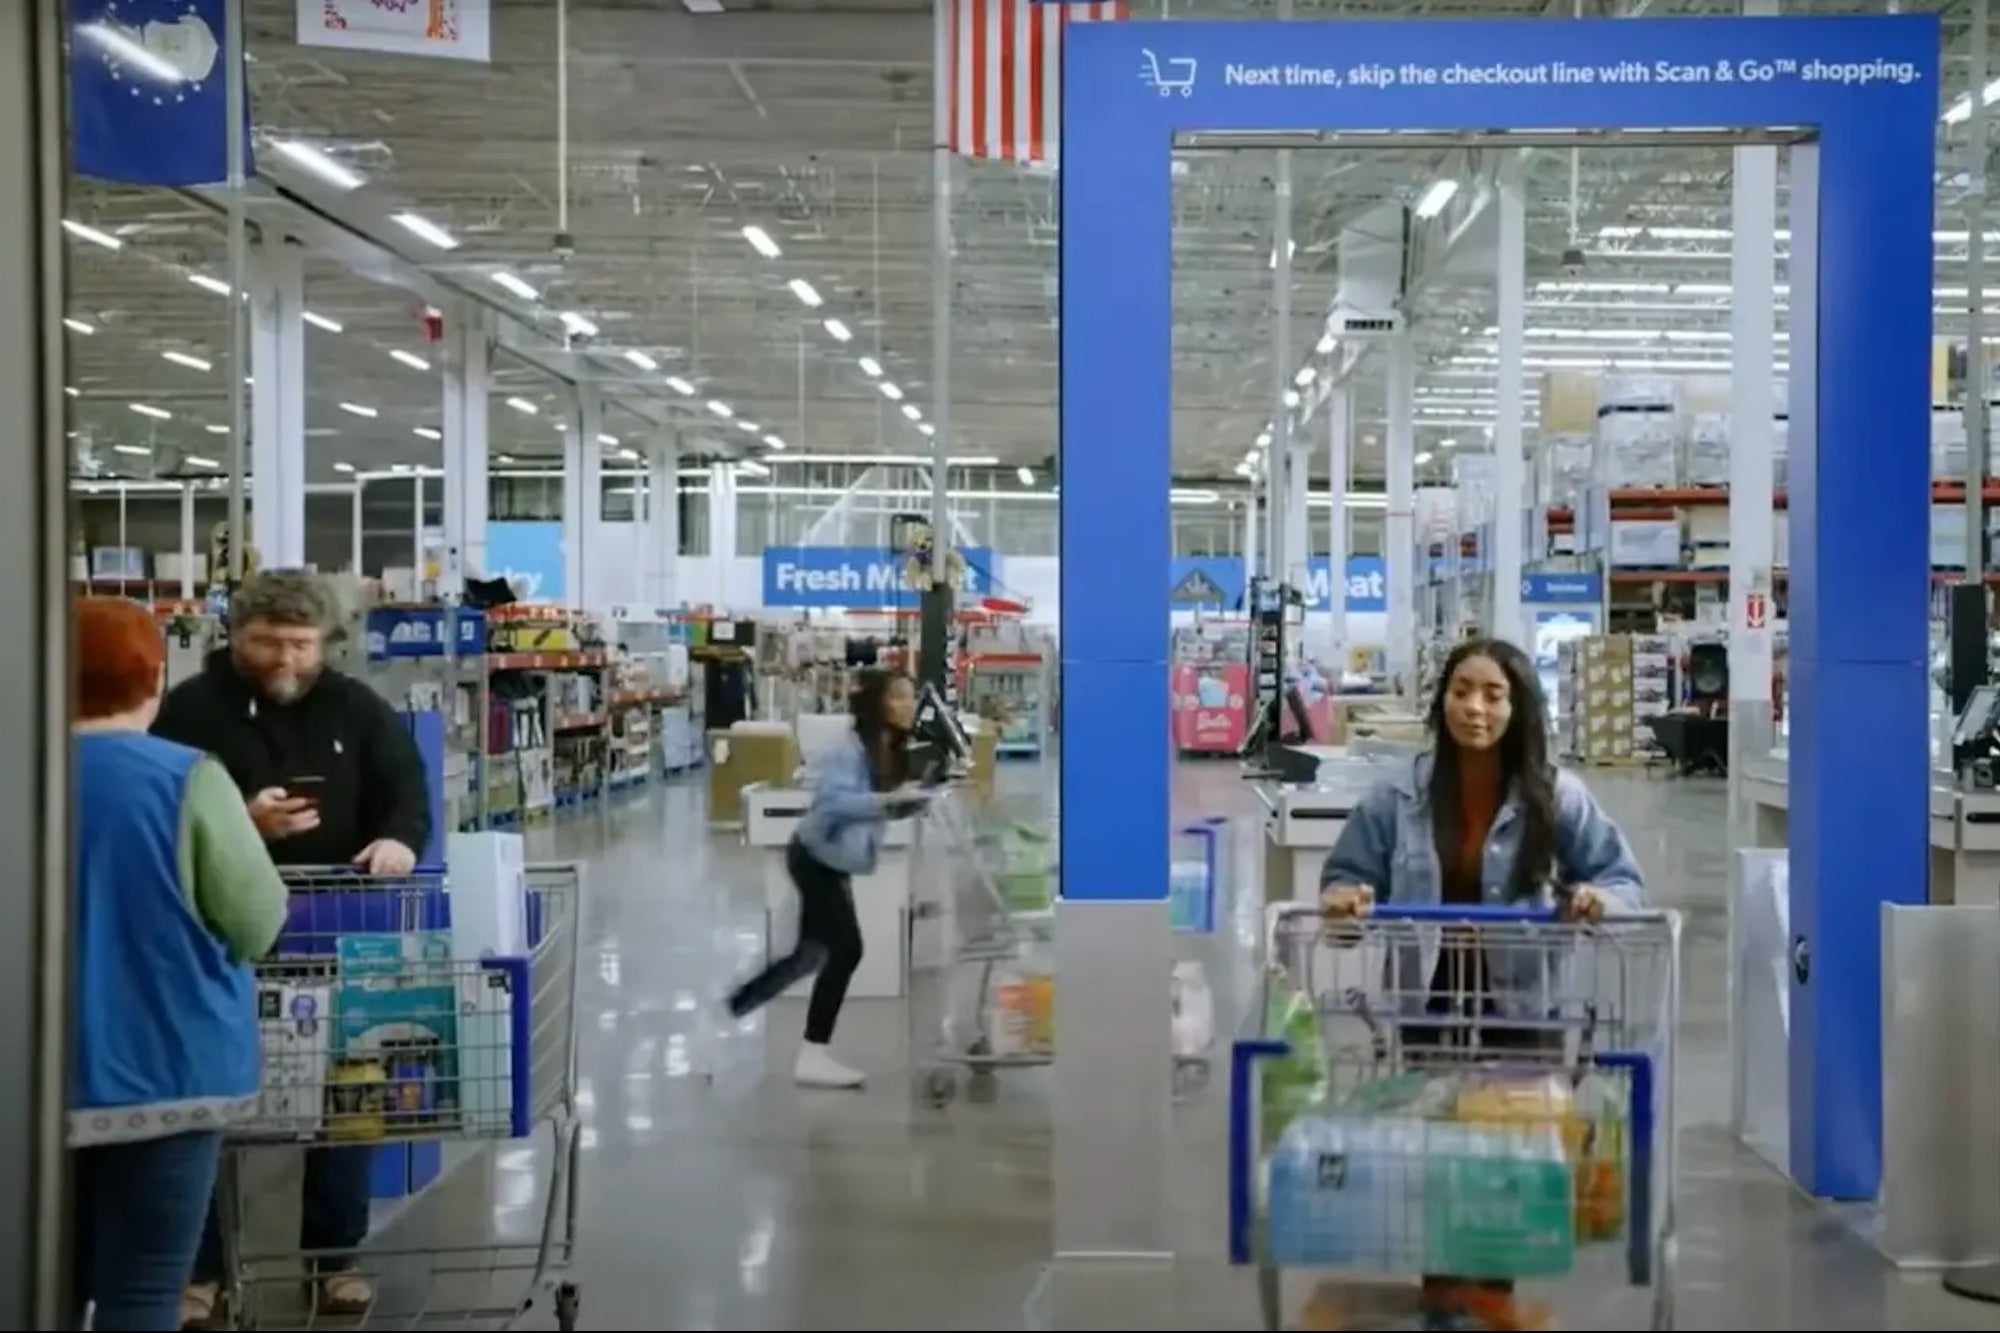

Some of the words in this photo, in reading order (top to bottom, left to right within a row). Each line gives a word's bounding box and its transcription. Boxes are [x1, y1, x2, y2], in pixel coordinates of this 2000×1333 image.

[1225, 64, 1279, 85] Next
[1284, 64, 1342, 88] time,
[1348, 63, 1395, 88] skip
[1400, 63, 1438, 84] the
[1442, 63, 1547, 84] checkout
[1552, 62, 1594, 83] line
[1599, 61, 1649, 82] with
[1654, 61, 1710, 82] Scan
[1714, 60, 1734, 82] &
[1801, 58, 1921, 85] shopping.
[776, 562, 861, 591] Fresh
